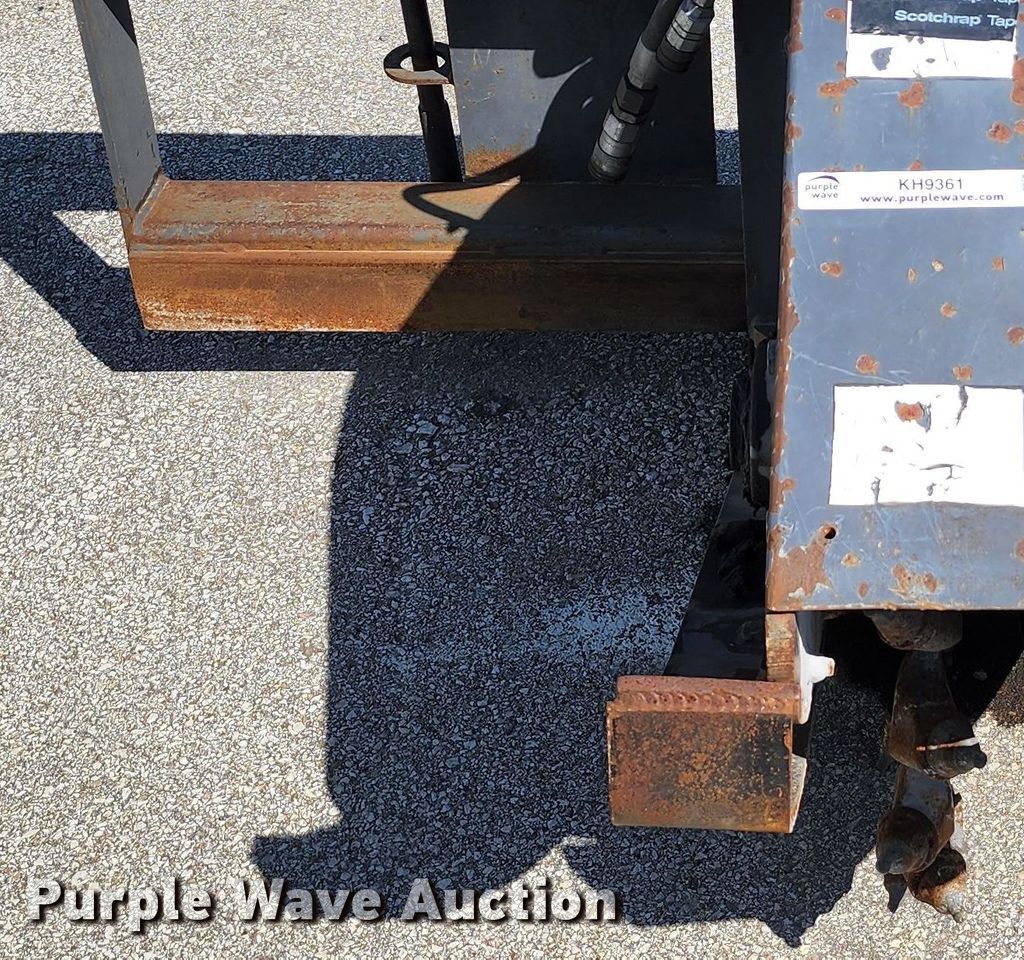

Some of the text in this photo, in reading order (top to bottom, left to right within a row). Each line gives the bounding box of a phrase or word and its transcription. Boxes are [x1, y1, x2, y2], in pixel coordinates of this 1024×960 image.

[894, 9, 1017, 27] Scotchrap Tap
[805, 182, 839, 192] purple
[898, 178, 964, 191] KH9361
[811, 191, 839, 199] wave
[860, 192, 1005, 203] www.purplewave.com
